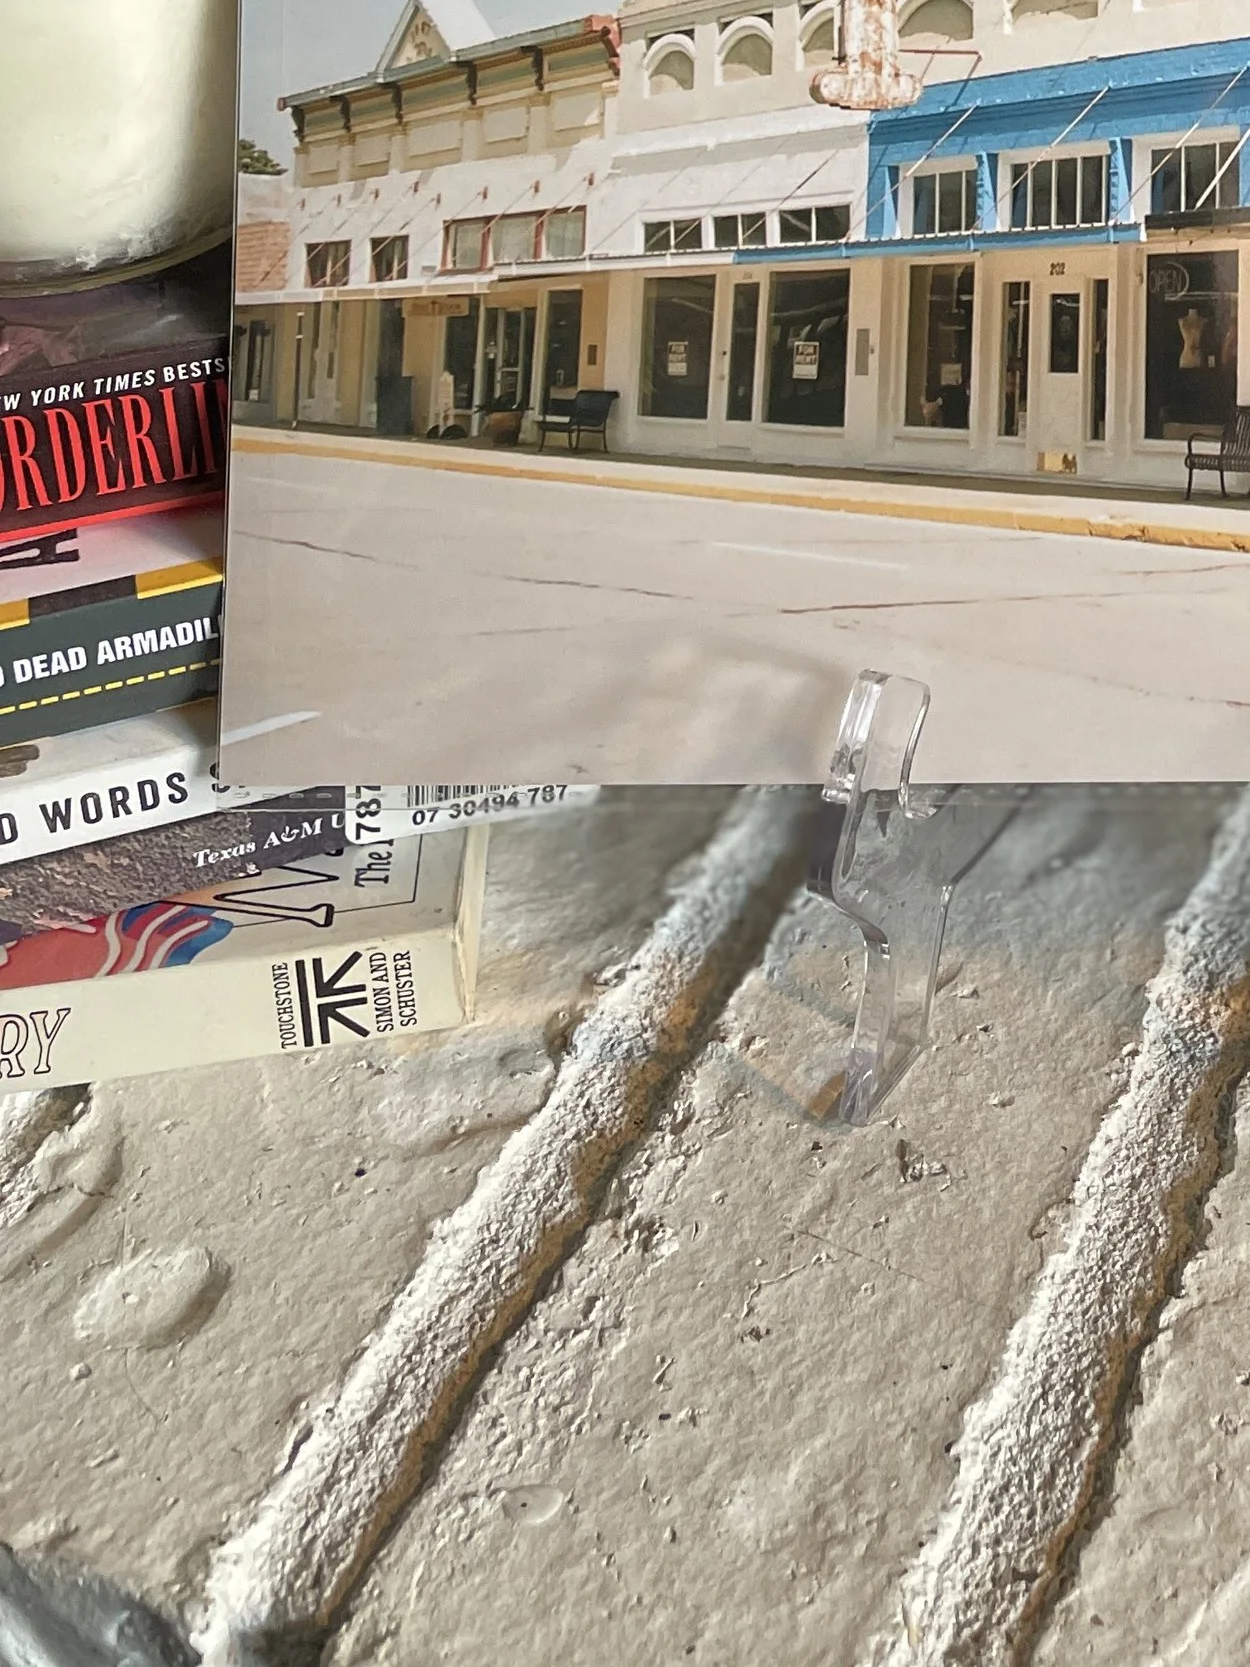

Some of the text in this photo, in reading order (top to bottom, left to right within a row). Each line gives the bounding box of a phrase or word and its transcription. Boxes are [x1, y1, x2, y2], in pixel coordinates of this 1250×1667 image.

[0, 393, 21, 411] W
[31, 382, 85, 407] YORK
[93, 370, 156, 395] TIMES
[0, 379, 228, 512] RDERLI
[13, 647, 87, 684] DEAD
[97, 614, 223, 665] ARMADIL
[39, 772, 189, 833] WORDS
[193, 842, 256, 867] Texas
[263, 818, 323, 849] A&M
[354, 851, 393, 888] The
[272, 962, 297, 1049] TOUCHSTONE
[369, 951, 394, 1033] SIMON AND
[393, 950, 417, 1027] SCHUSTER
